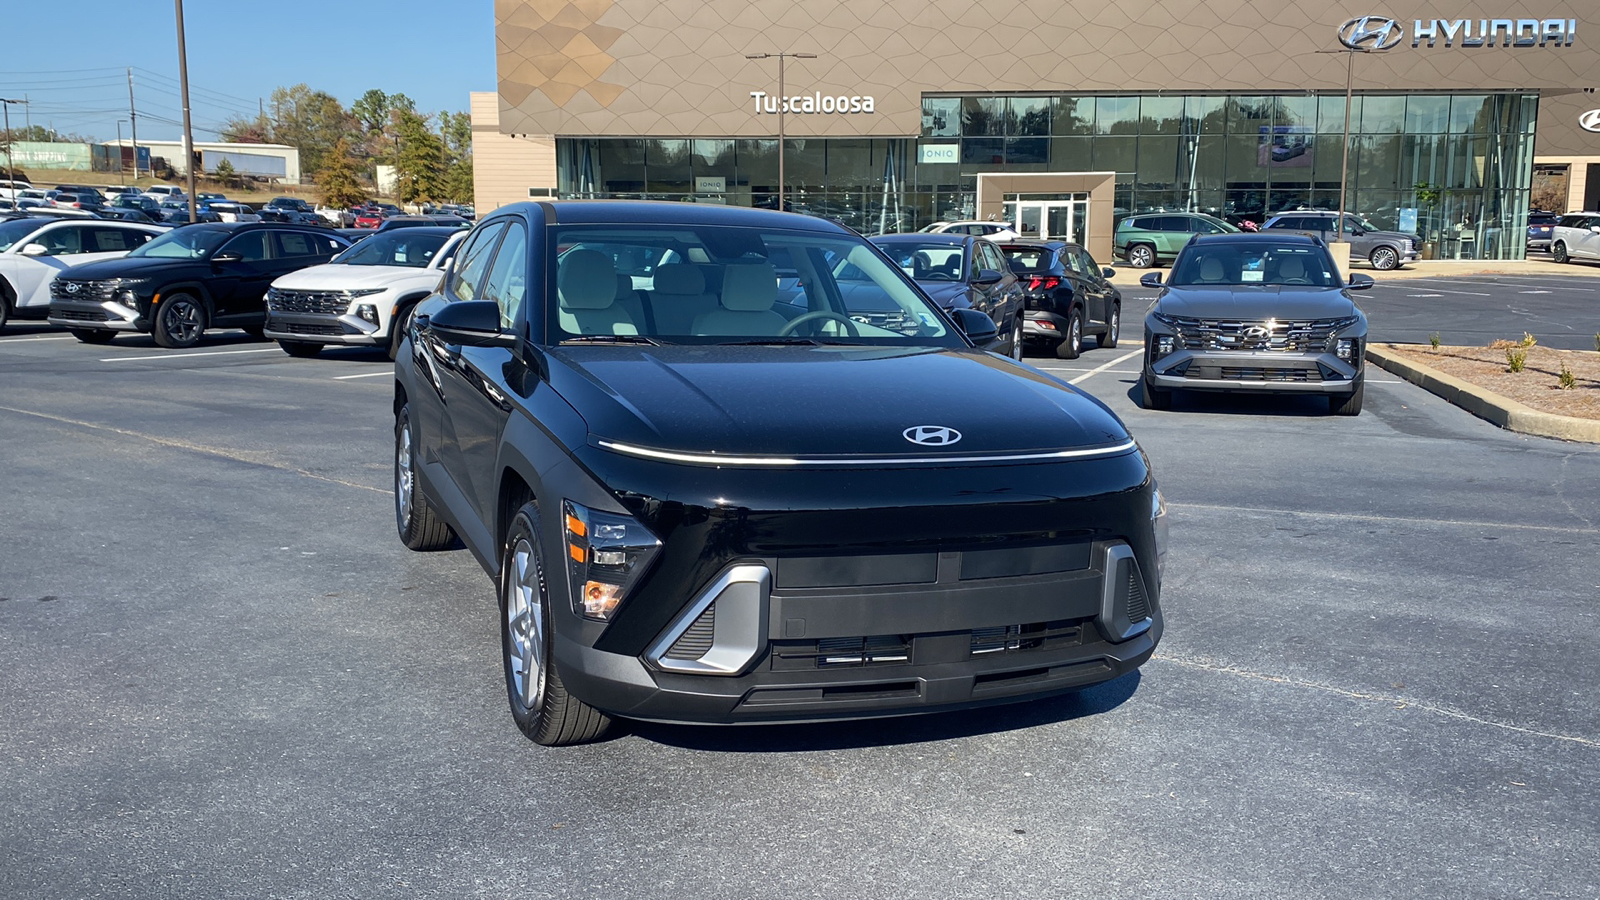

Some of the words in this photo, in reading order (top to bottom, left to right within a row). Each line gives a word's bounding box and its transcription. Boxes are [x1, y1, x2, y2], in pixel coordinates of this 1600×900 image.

[1411, 18, 1576, 48] HYUNDAI
[749, 90, 875, 114] Tuscaloosa
[33, 151, 67, 162] SHIPPING
